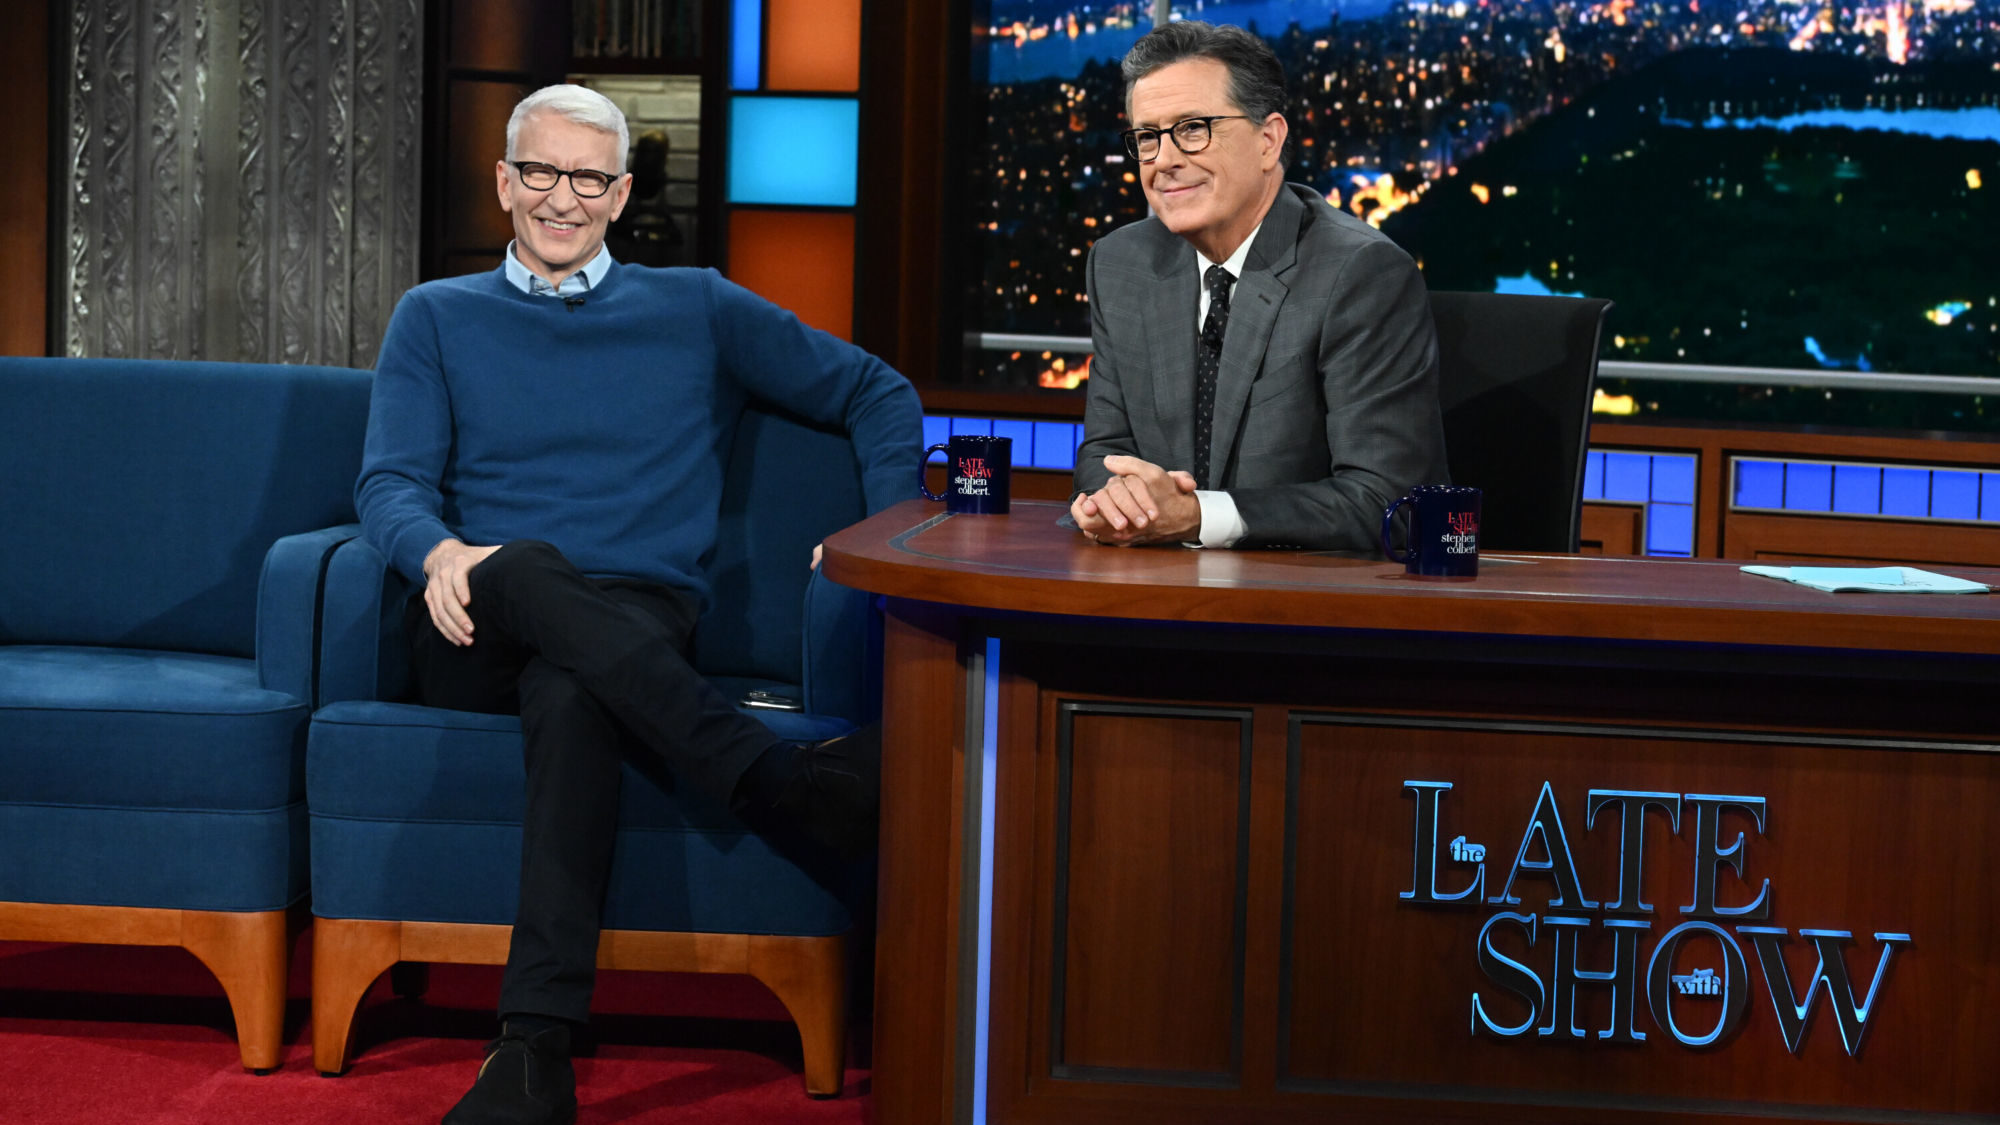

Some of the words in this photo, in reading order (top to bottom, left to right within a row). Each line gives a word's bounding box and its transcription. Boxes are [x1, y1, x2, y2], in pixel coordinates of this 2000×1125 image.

[958, 457, 985, 468] LATE
[962, 467, 993, 478] SHOW
[954, 474, 987, 489] stephen
[1441, 531, 1475, 547] stephen
[1400, 780, 1770, 918] LATE
[1450, 836, 1485, 863] the
[1472, 911, 1911, 1056] SHOW
[1672, 968, 1722, 995] with
